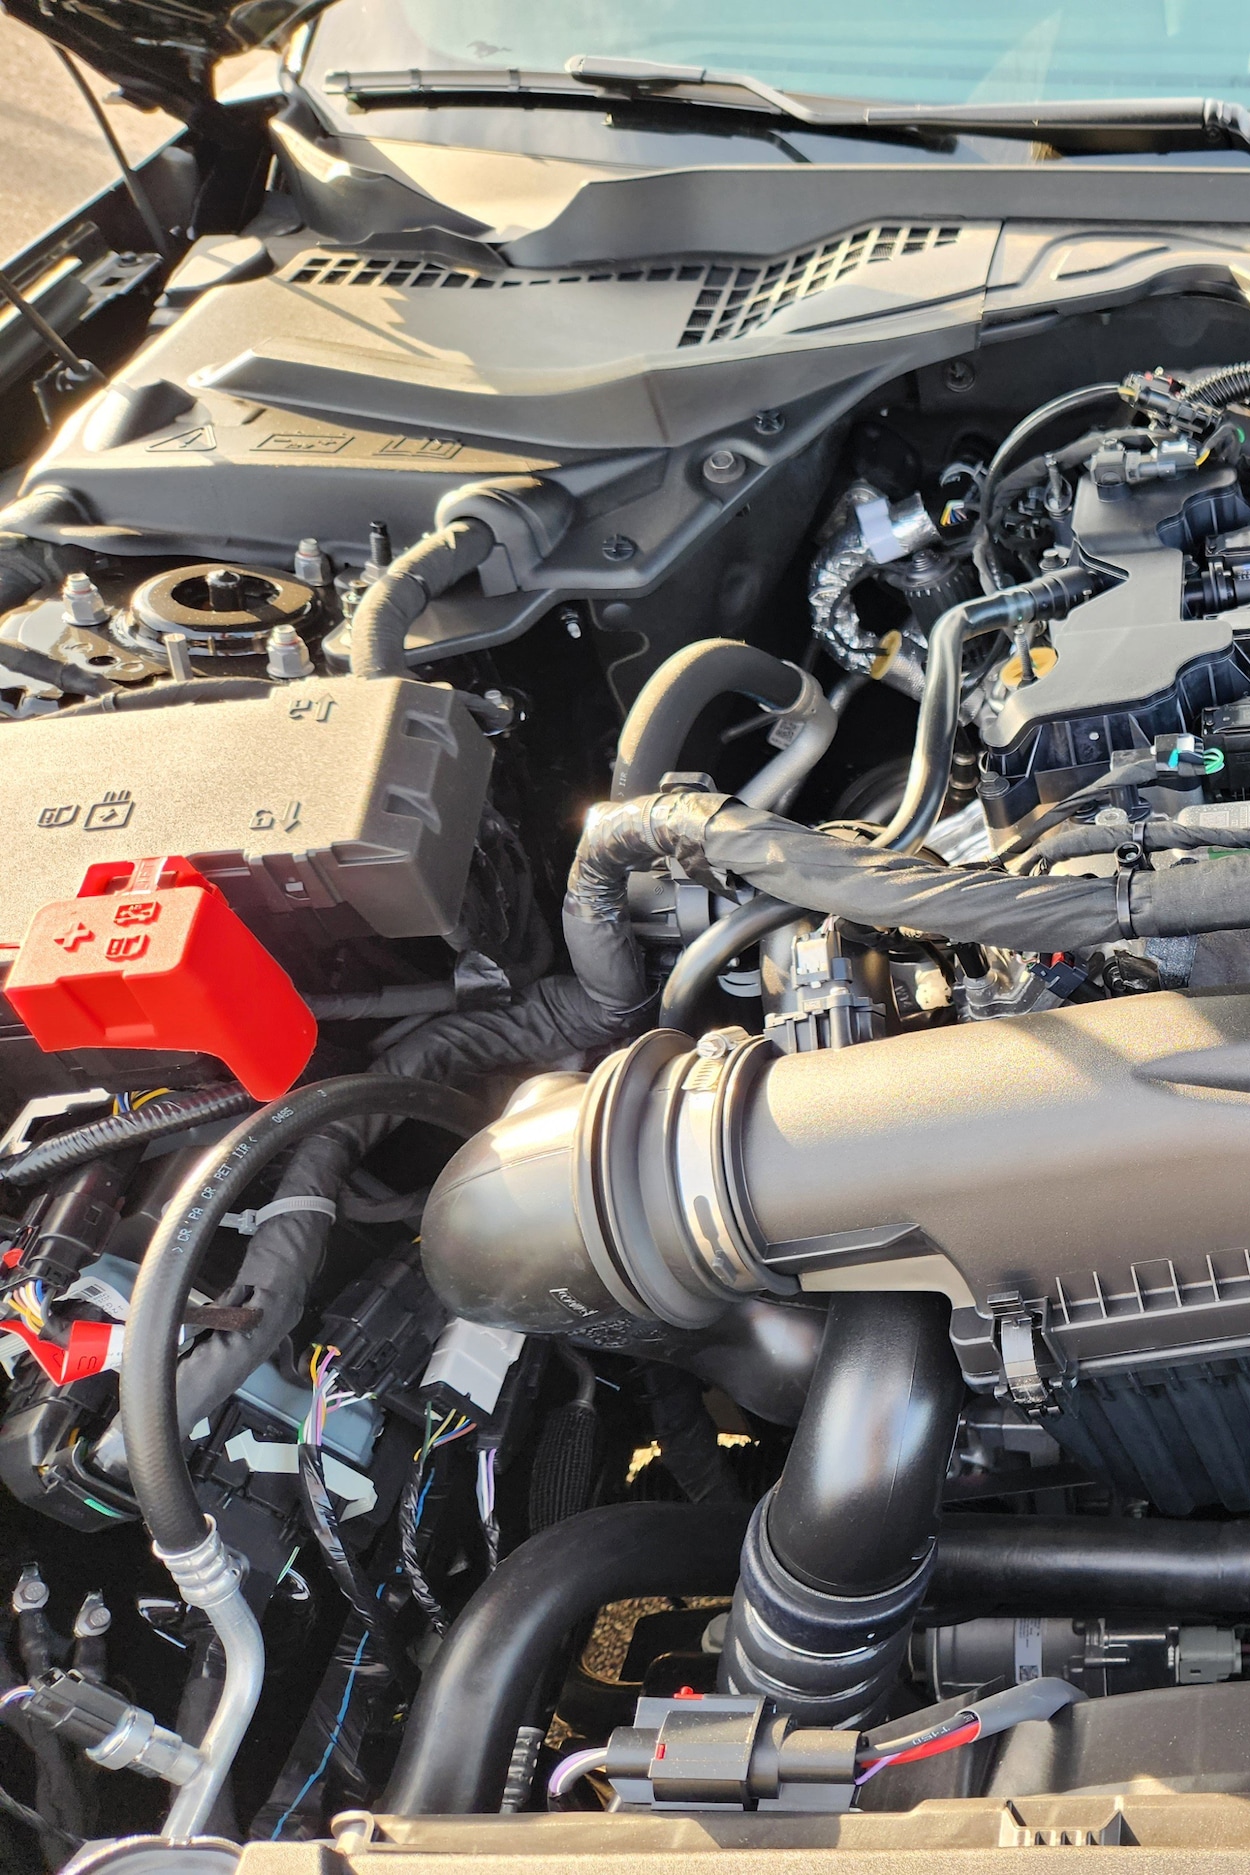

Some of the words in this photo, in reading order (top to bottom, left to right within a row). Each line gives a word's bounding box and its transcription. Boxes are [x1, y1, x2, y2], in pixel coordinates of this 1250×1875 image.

[177, 1228, 193, 1243] CR
[187, 1207, 204, 1221] PA
[200, 1186, 217, 1200] CR
[212, 1162, 233, 1181] PET
